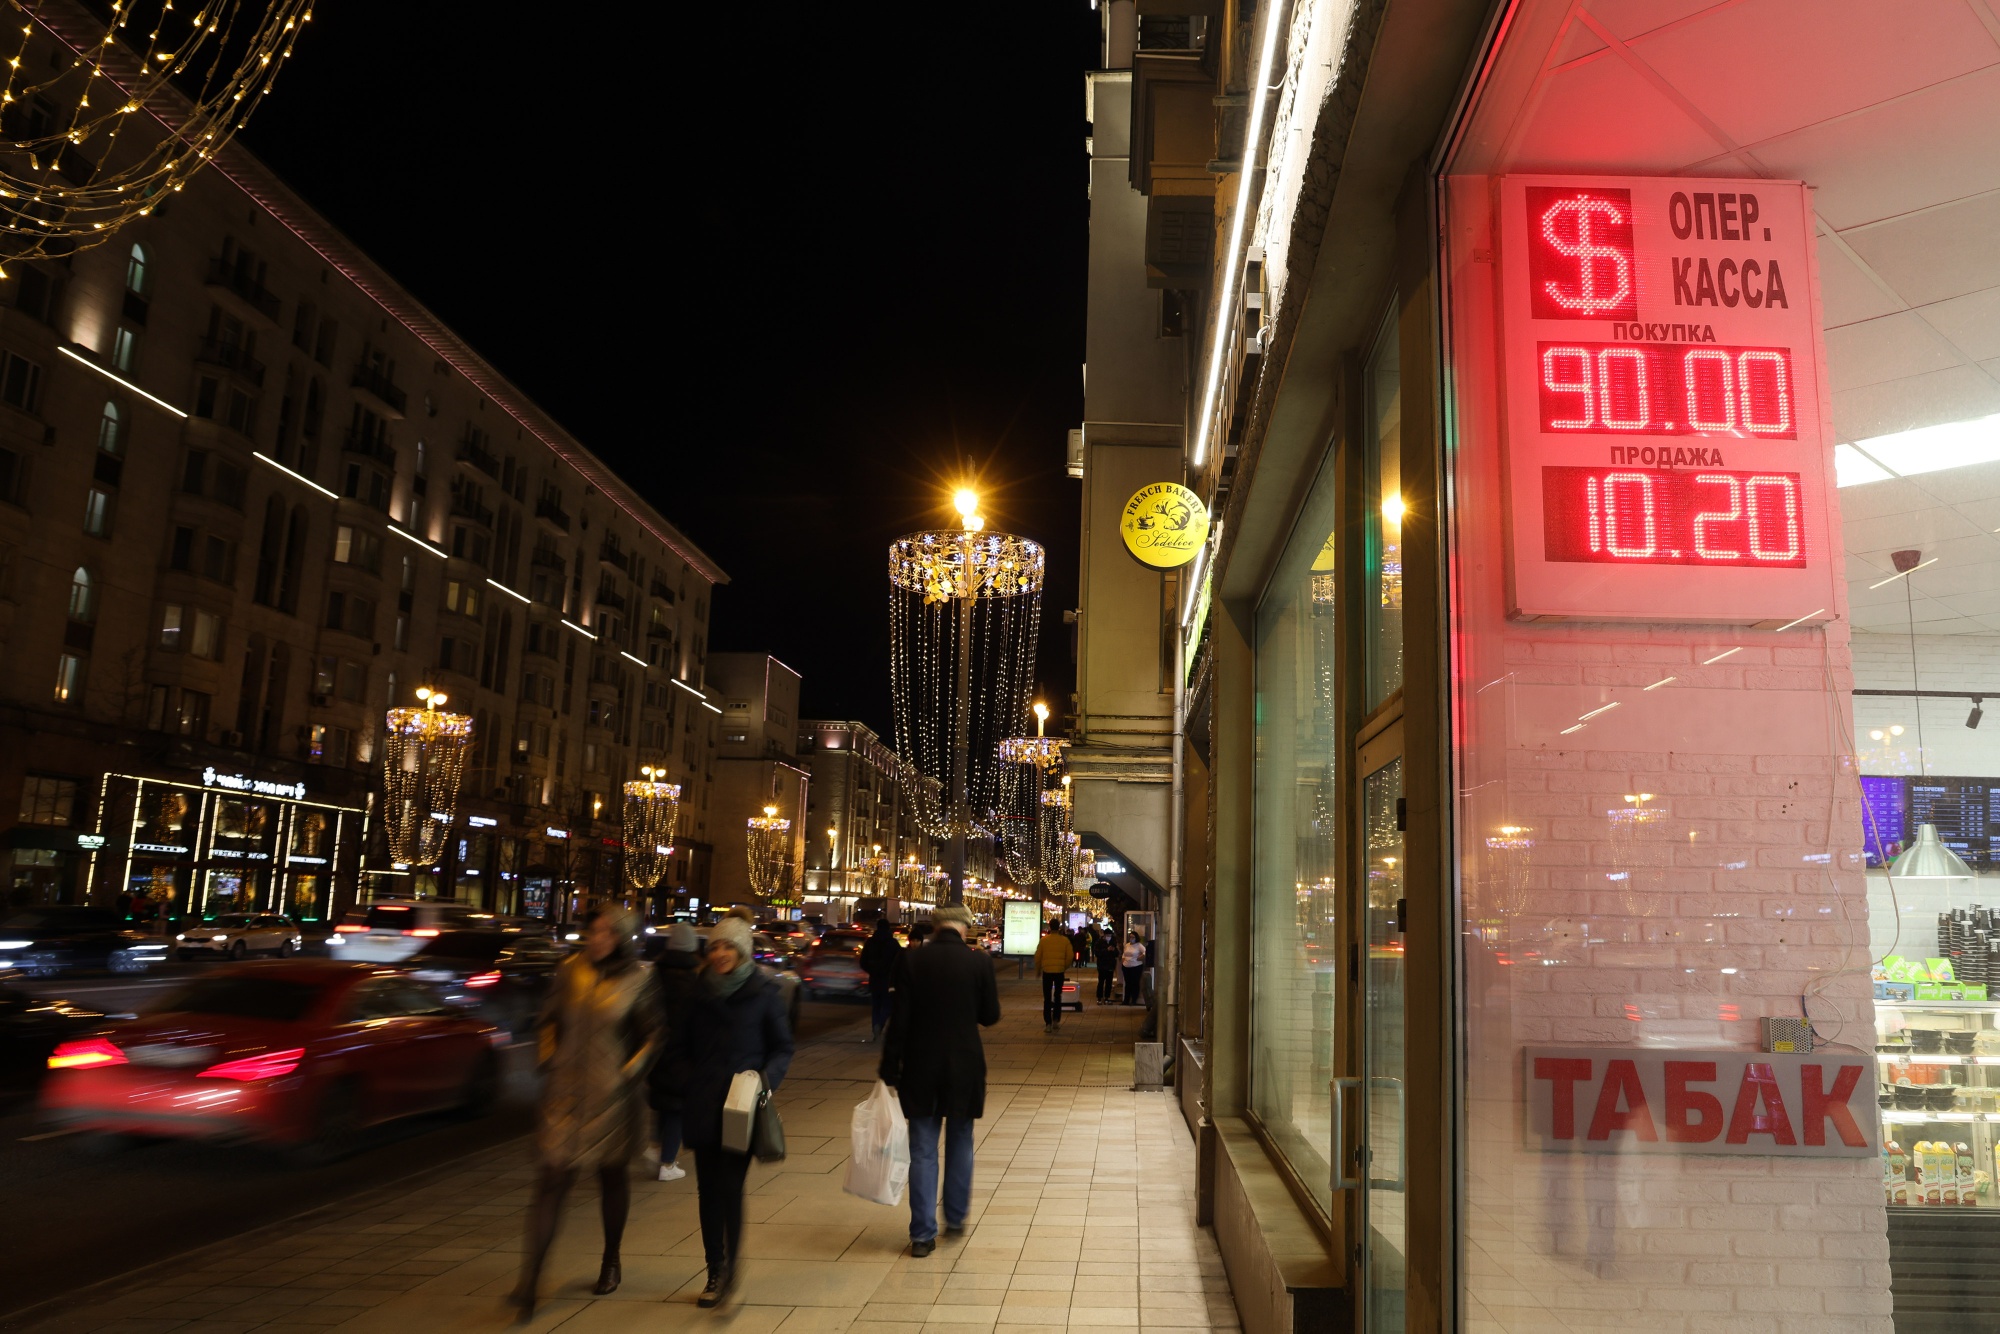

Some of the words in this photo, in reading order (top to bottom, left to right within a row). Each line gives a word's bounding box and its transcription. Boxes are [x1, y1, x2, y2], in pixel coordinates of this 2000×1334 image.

[1668, 191, 1772, 242] ОПЕР.
[1671, 256, 1789, 310] КАССА
[1612, 322, 1717, 343] ПОКУПКА
[1542, 346, 1790, 433] 90.00
[1609, 445, 1725, 469] ПРОДАЖА
[1126, 485, 1162, 516] FRENCH
[1165, 485, 1203, 515] BAKERY
[1917, 987, 1938, 998] jump
[1965, 988, 1985, 999] jump
[1533, 1057, 1869, 1148] ТАБАК
